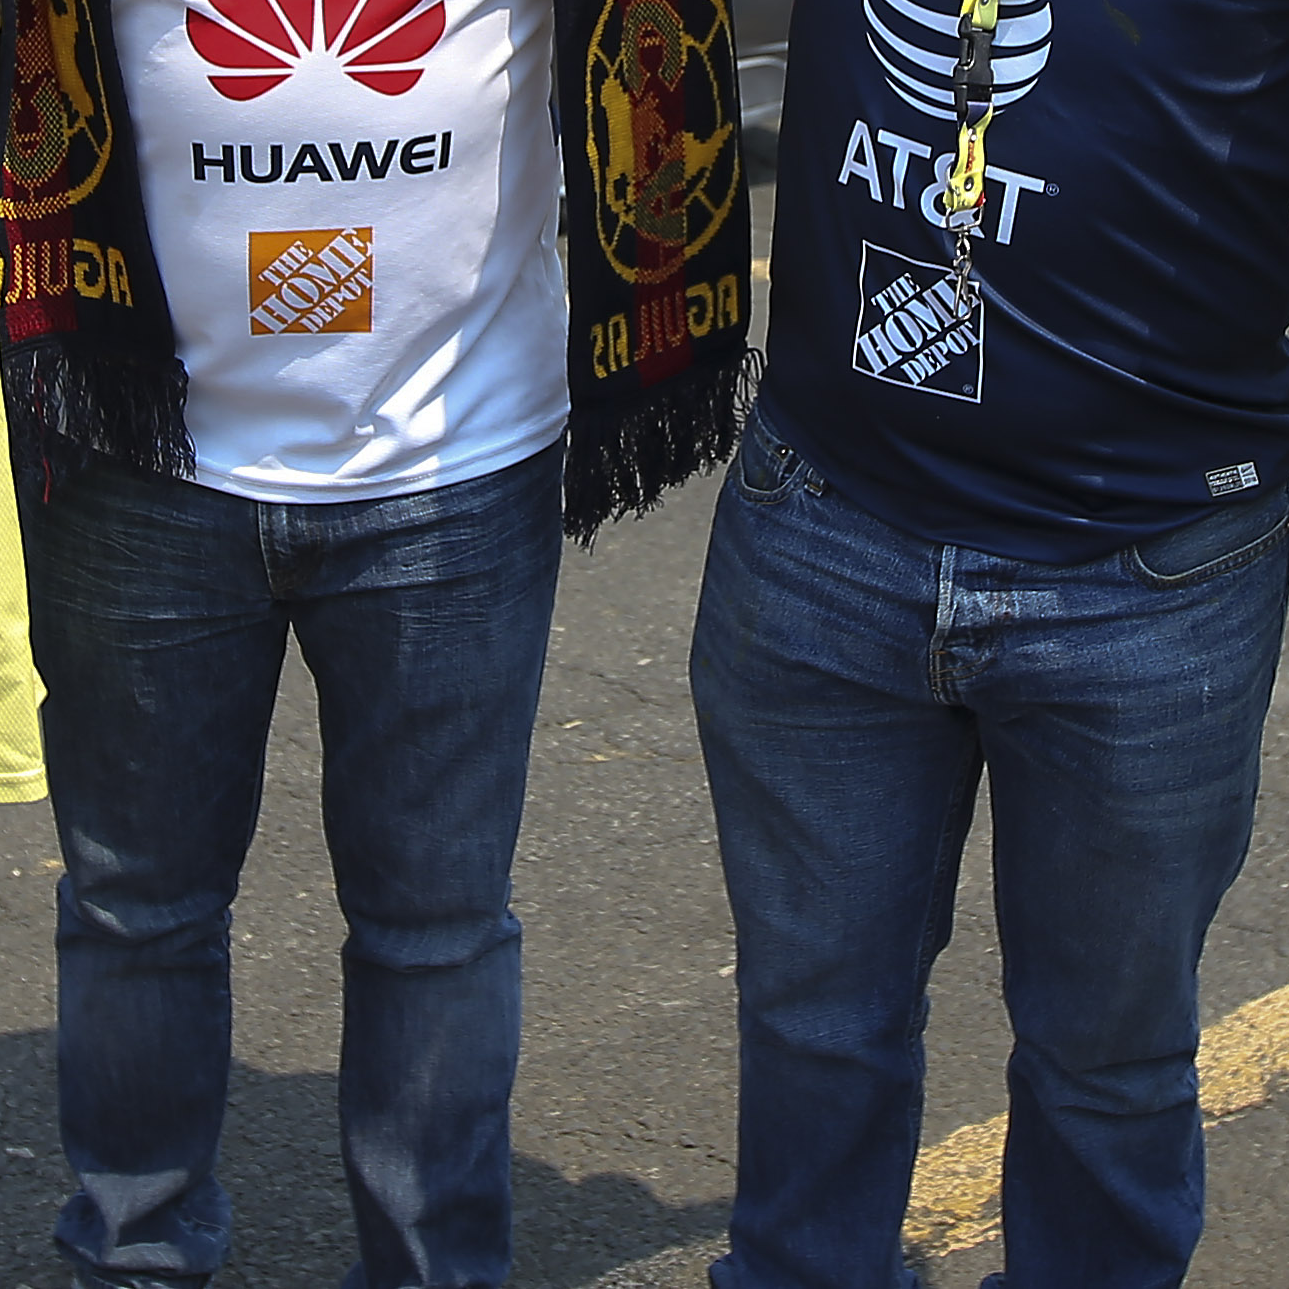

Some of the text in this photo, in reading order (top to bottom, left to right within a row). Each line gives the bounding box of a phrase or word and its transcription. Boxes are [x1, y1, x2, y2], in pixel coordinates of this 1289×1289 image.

[190, 130, 453, 184] HUAWEI
[249, 227, 374, 334] HOME
[257, 239, 314, 287] THE
[298, 267, 374, 334] DEPOT
[870, 272, 921, 316] THE
[899, 321, 981, 387] DEPOT
